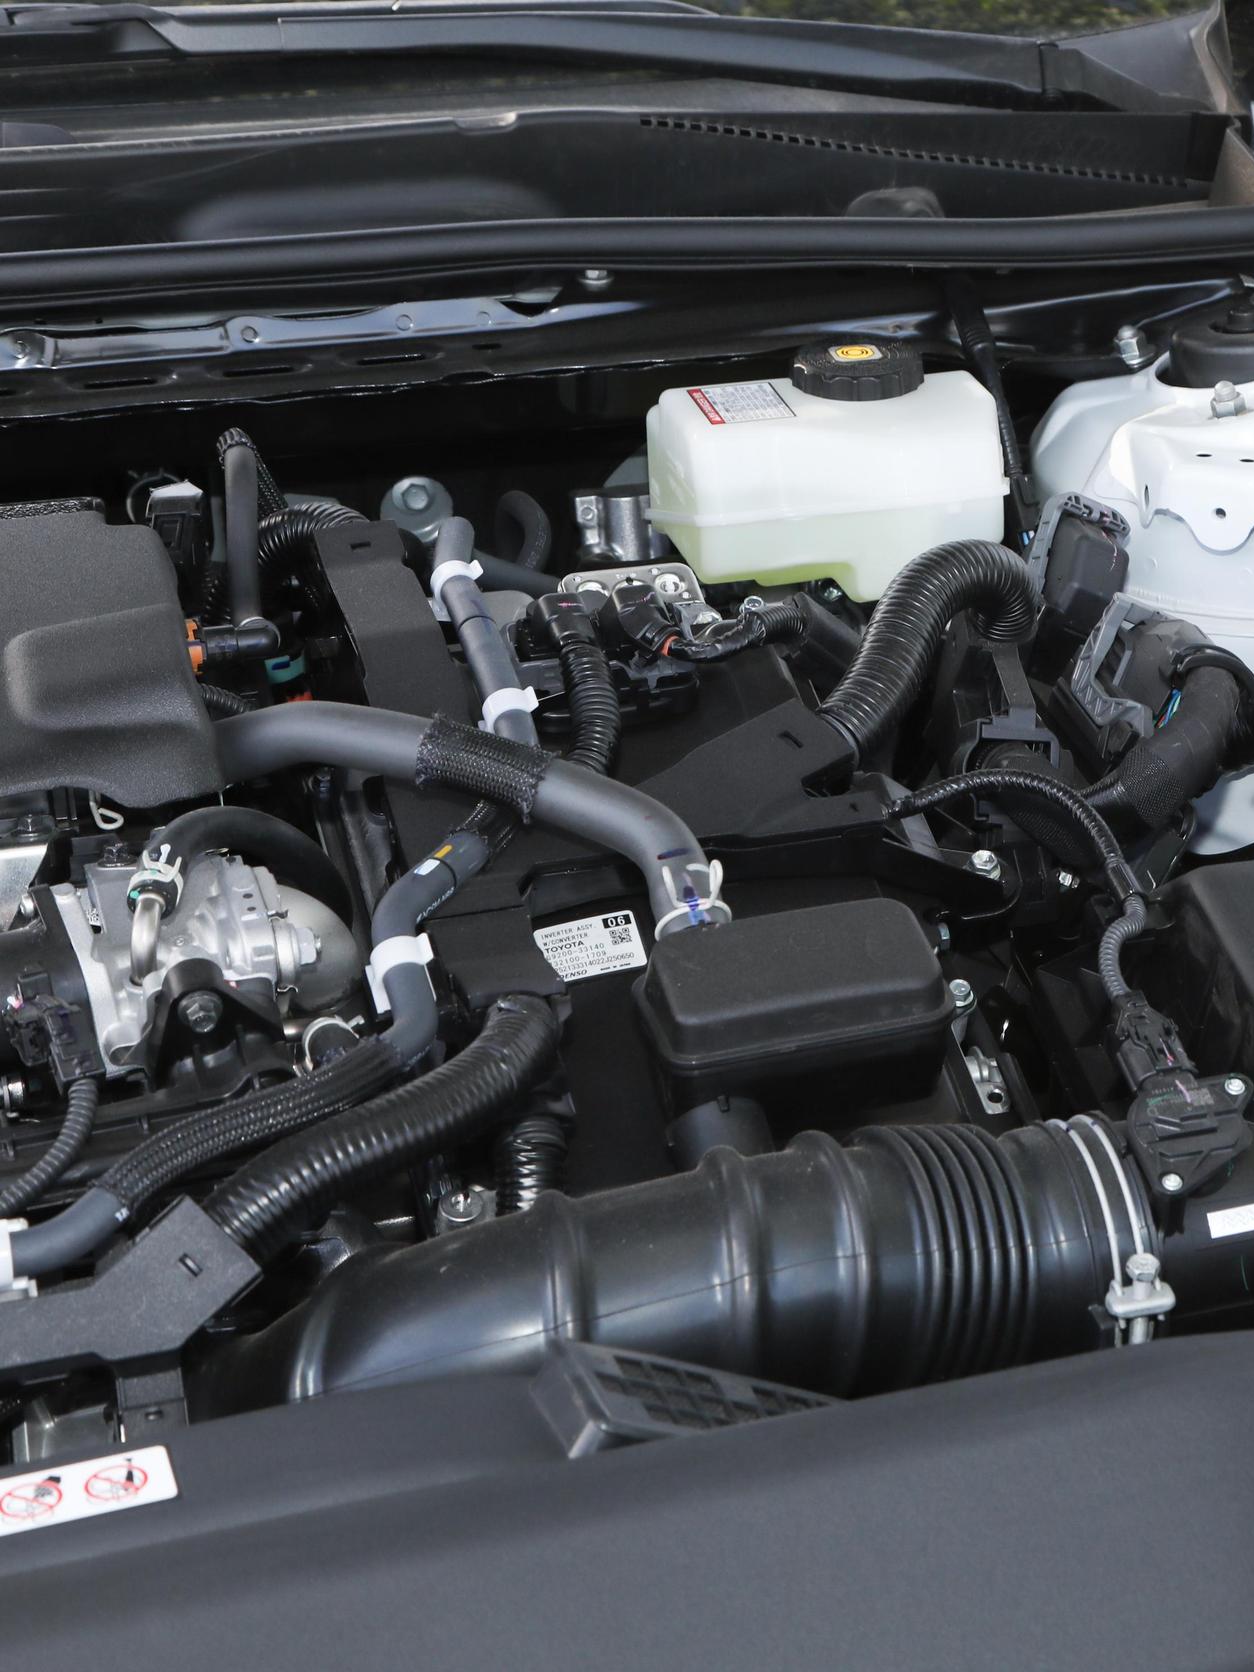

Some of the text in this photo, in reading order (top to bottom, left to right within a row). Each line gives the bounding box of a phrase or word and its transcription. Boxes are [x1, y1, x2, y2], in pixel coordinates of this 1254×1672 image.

[608, 917, 625, 927] 06
[541, 927, 572, 940] INVERTER
[545, 940, 585, 954] TOYOTA
[560, 969, 588, 979] DENSO
